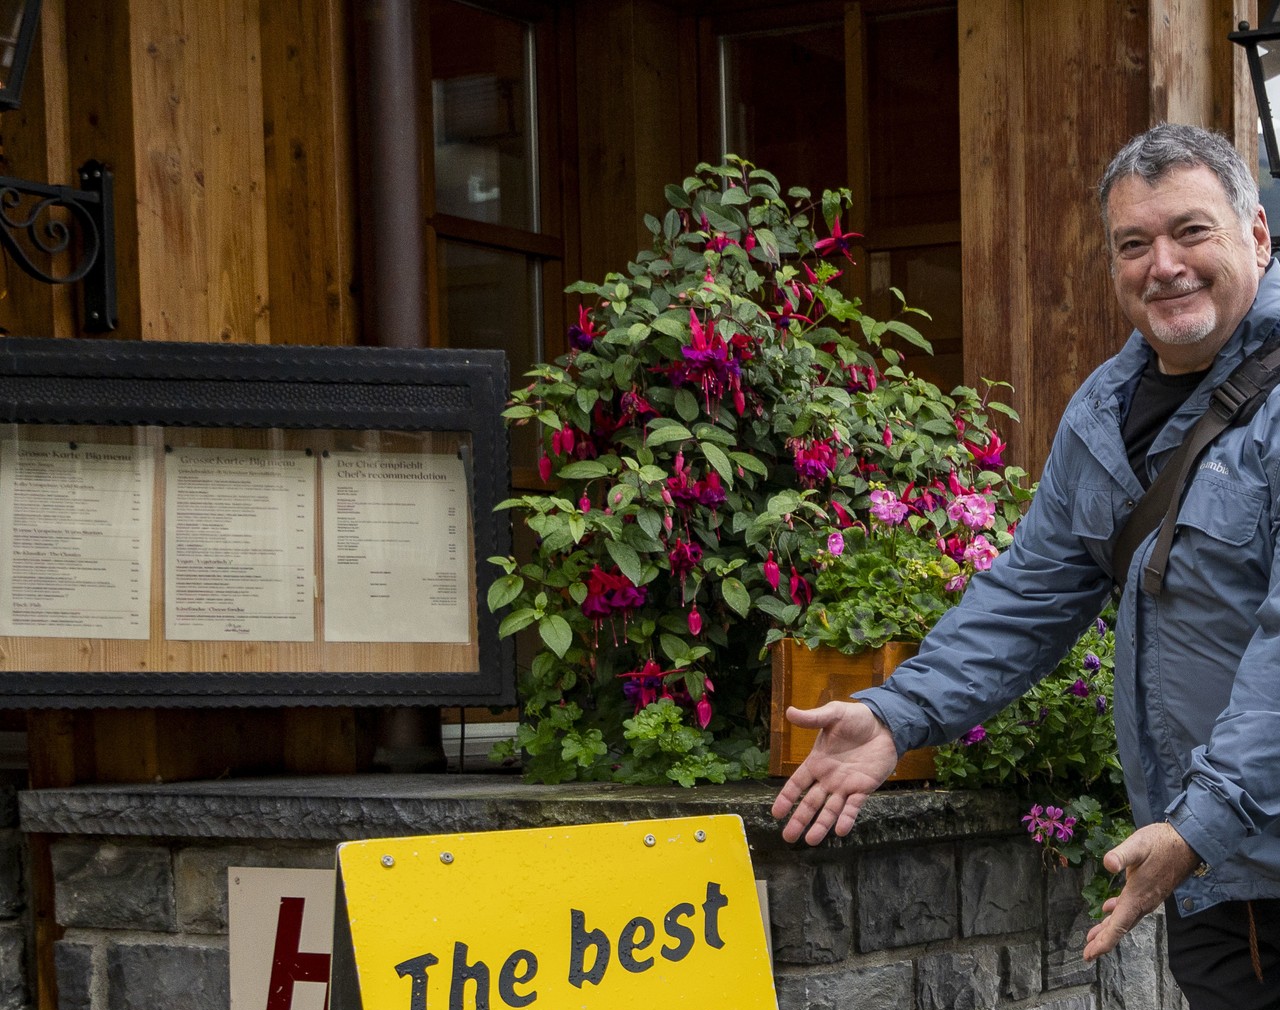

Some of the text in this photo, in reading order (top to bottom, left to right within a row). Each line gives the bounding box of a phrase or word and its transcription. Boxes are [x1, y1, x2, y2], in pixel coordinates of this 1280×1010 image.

[337, 460, 354, 468] Der
[368, 472, 447, 480] recommendation
[568, 881, 729, 989] best
